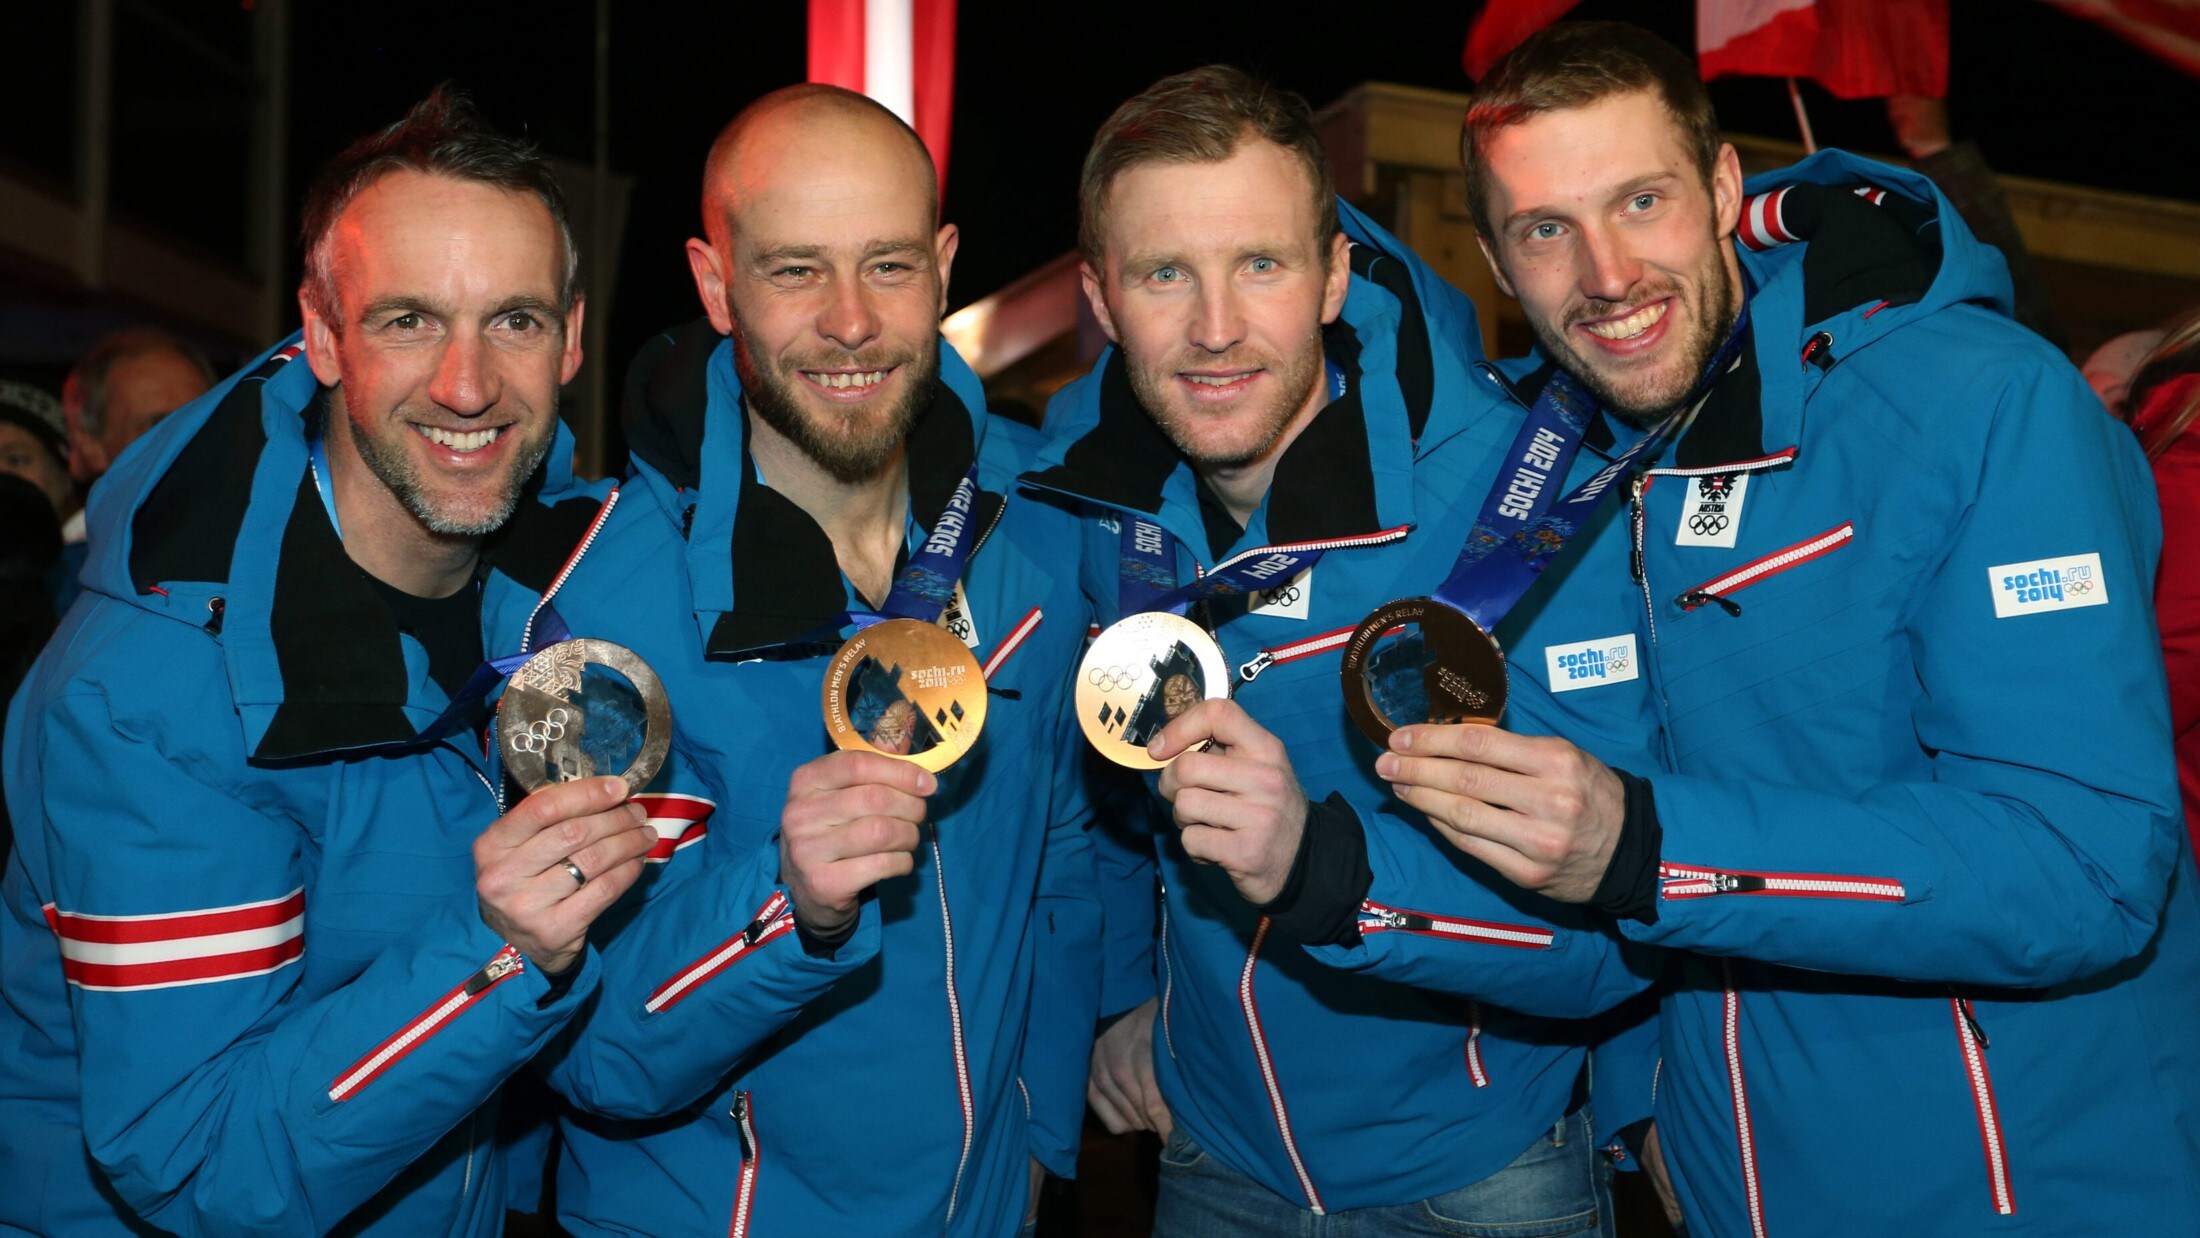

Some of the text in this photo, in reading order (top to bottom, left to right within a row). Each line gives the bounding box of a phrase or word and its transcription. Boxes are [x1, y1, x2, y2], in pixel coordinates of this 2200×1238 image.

[1498, 427, 1565, 521] SOCHI 2014
[925, 510, 966, 557] SOCHI
[1135, 521, 1162, 556] SOCHI
[1241, 553, 1298, 580] 2014
[2003, 565, 2092, 591] sochi.ru
[2016, 584, 2065, 603] 2014
[1395, 607, 1425, 619] RELAY
[1557, 645, 1628, 669] sochi.ru
[1568, 662, 1606, 680] 2014
[830, 638, 866, 733] BIATHLON MEN'S RELAY
